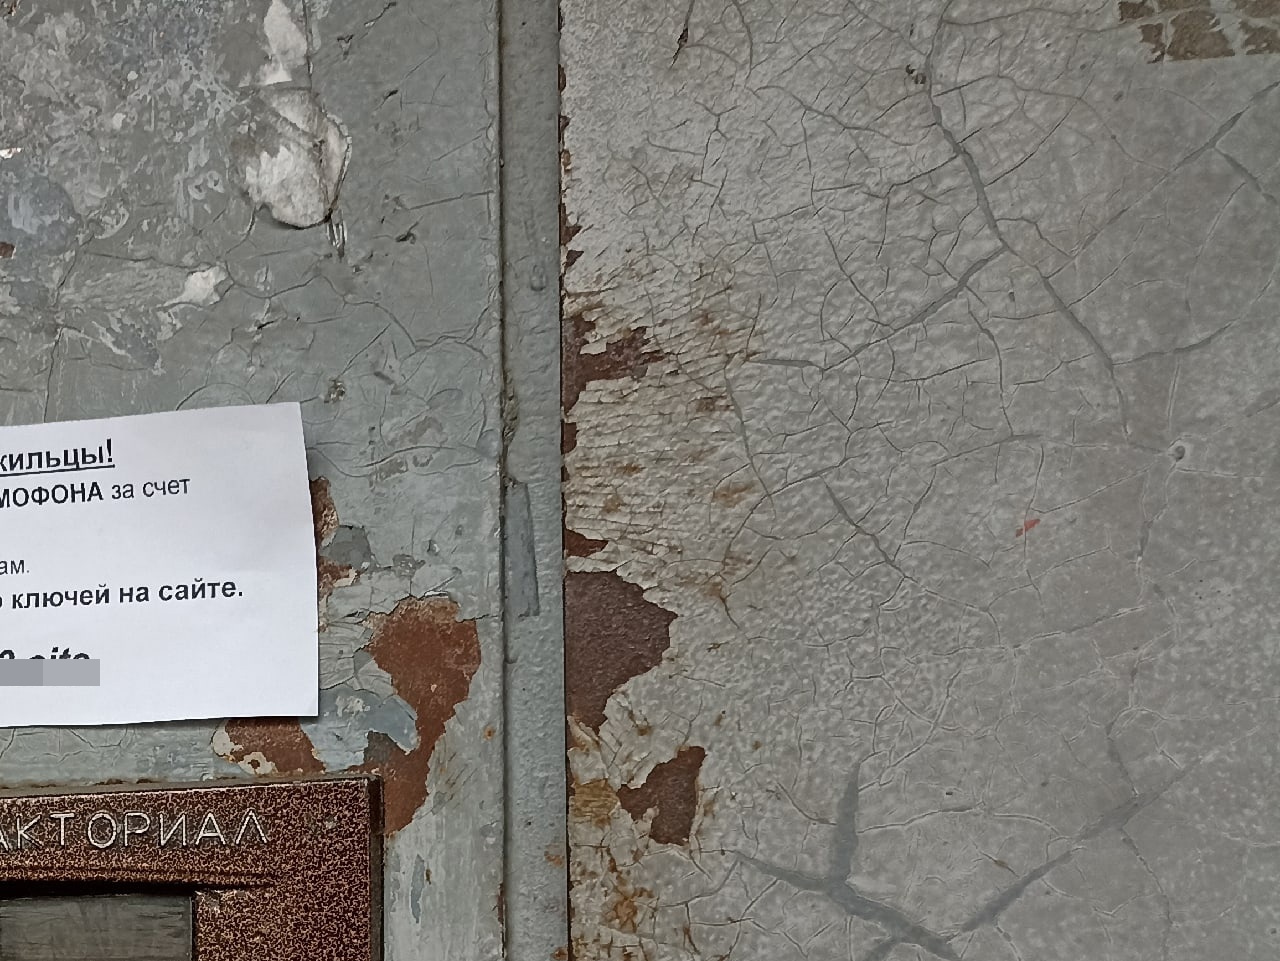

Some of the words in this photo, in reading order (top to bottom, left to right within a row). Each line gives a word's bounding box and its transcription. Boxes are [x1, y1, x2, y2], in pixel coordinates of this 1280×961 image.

[111, 484, 135, 500] за
[142, 478, 191, 498] счет
[11, 583, 110, 609] ключей
[119, 586, 150, 603] на
[158, 577, 244, 602] сайте.
